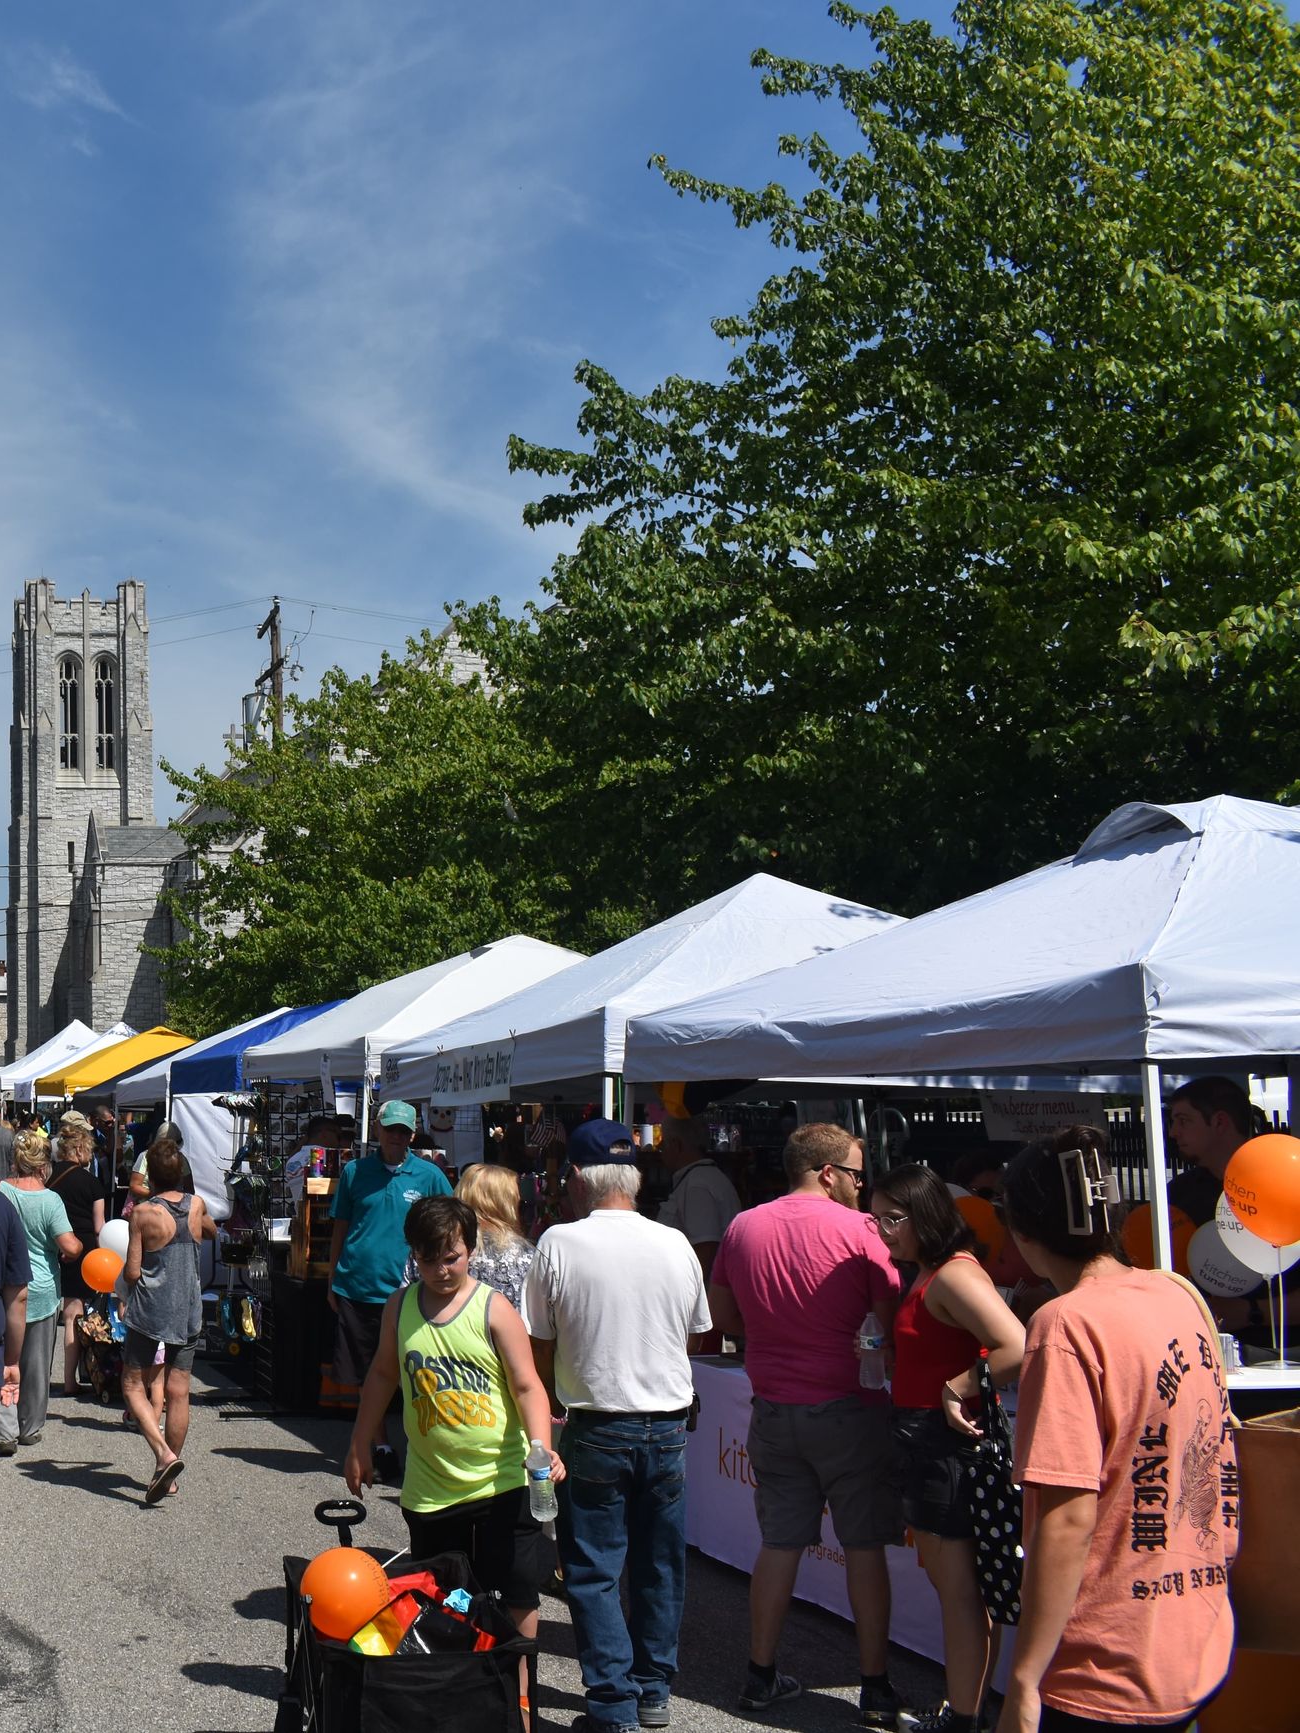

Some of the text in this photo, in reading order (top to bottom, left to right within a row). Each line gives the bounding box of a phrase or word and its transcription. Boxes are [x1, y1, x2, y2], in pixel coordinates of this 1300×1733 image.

[1199, 1268, 1243, 1294] tune-up
[1203, 1258, 1247, 1286] kitchen
[412, 1391, 497, 1437] VIBES
[1131, 1422, 1169, 1553] WINE
[1156, 1338, 1191, 1409] ME
[806, 1543, 846, 1567] pgrade
